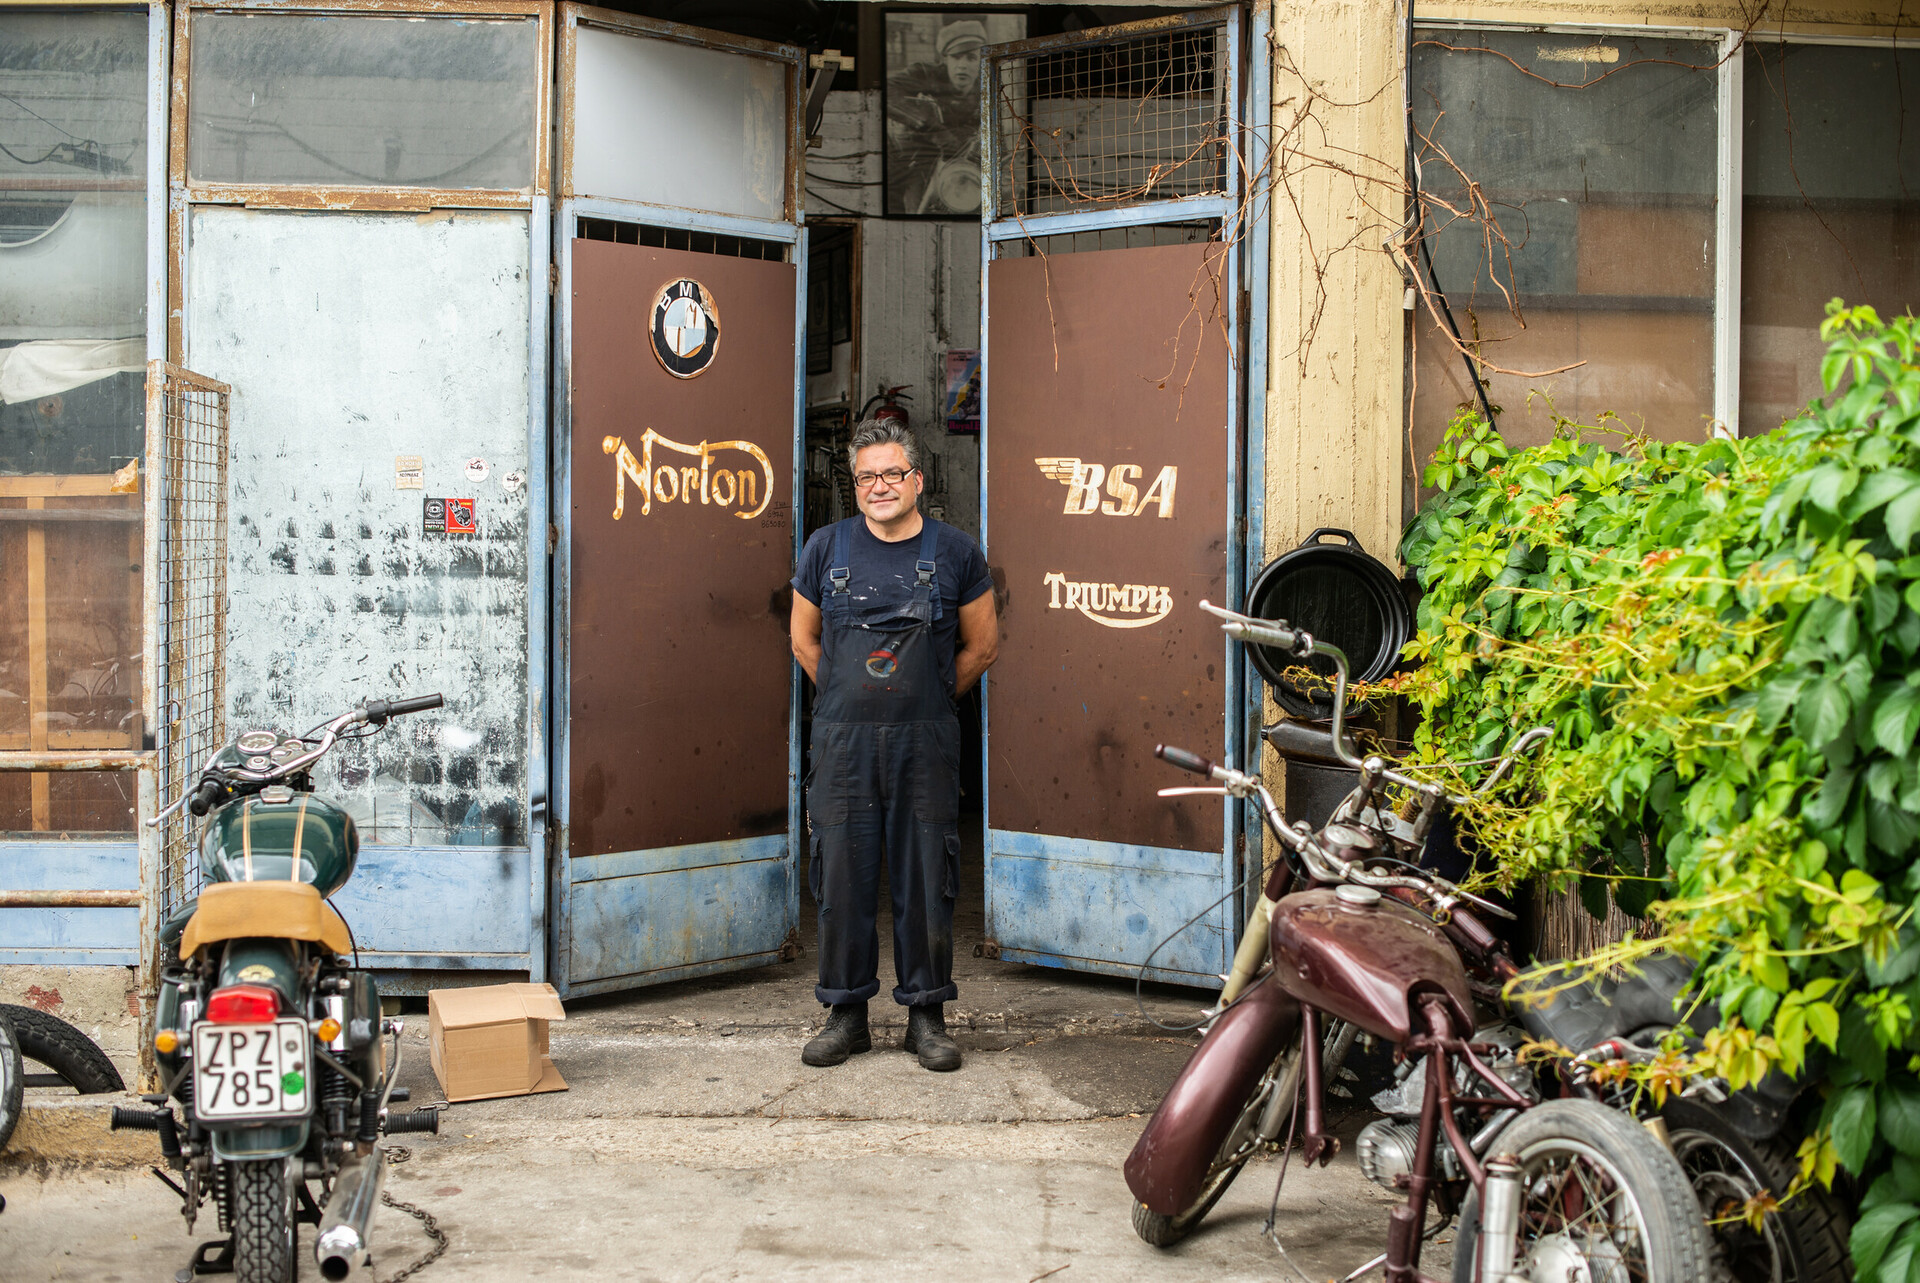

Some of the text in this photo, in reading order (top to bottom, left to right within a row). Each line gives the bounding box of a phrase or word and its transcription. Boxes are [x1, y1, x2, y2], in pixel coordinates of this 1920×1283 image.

[660, 281, 700, 311] BM
[602, 427, 774, 520] Norton
[1063, 464, 1178, 518] BSA
[1043, 572, 1174, 629] TRIUMPH
[206, 1030, 273, 1067] ZPZ
[207, 1069, 274, 1109] 785
